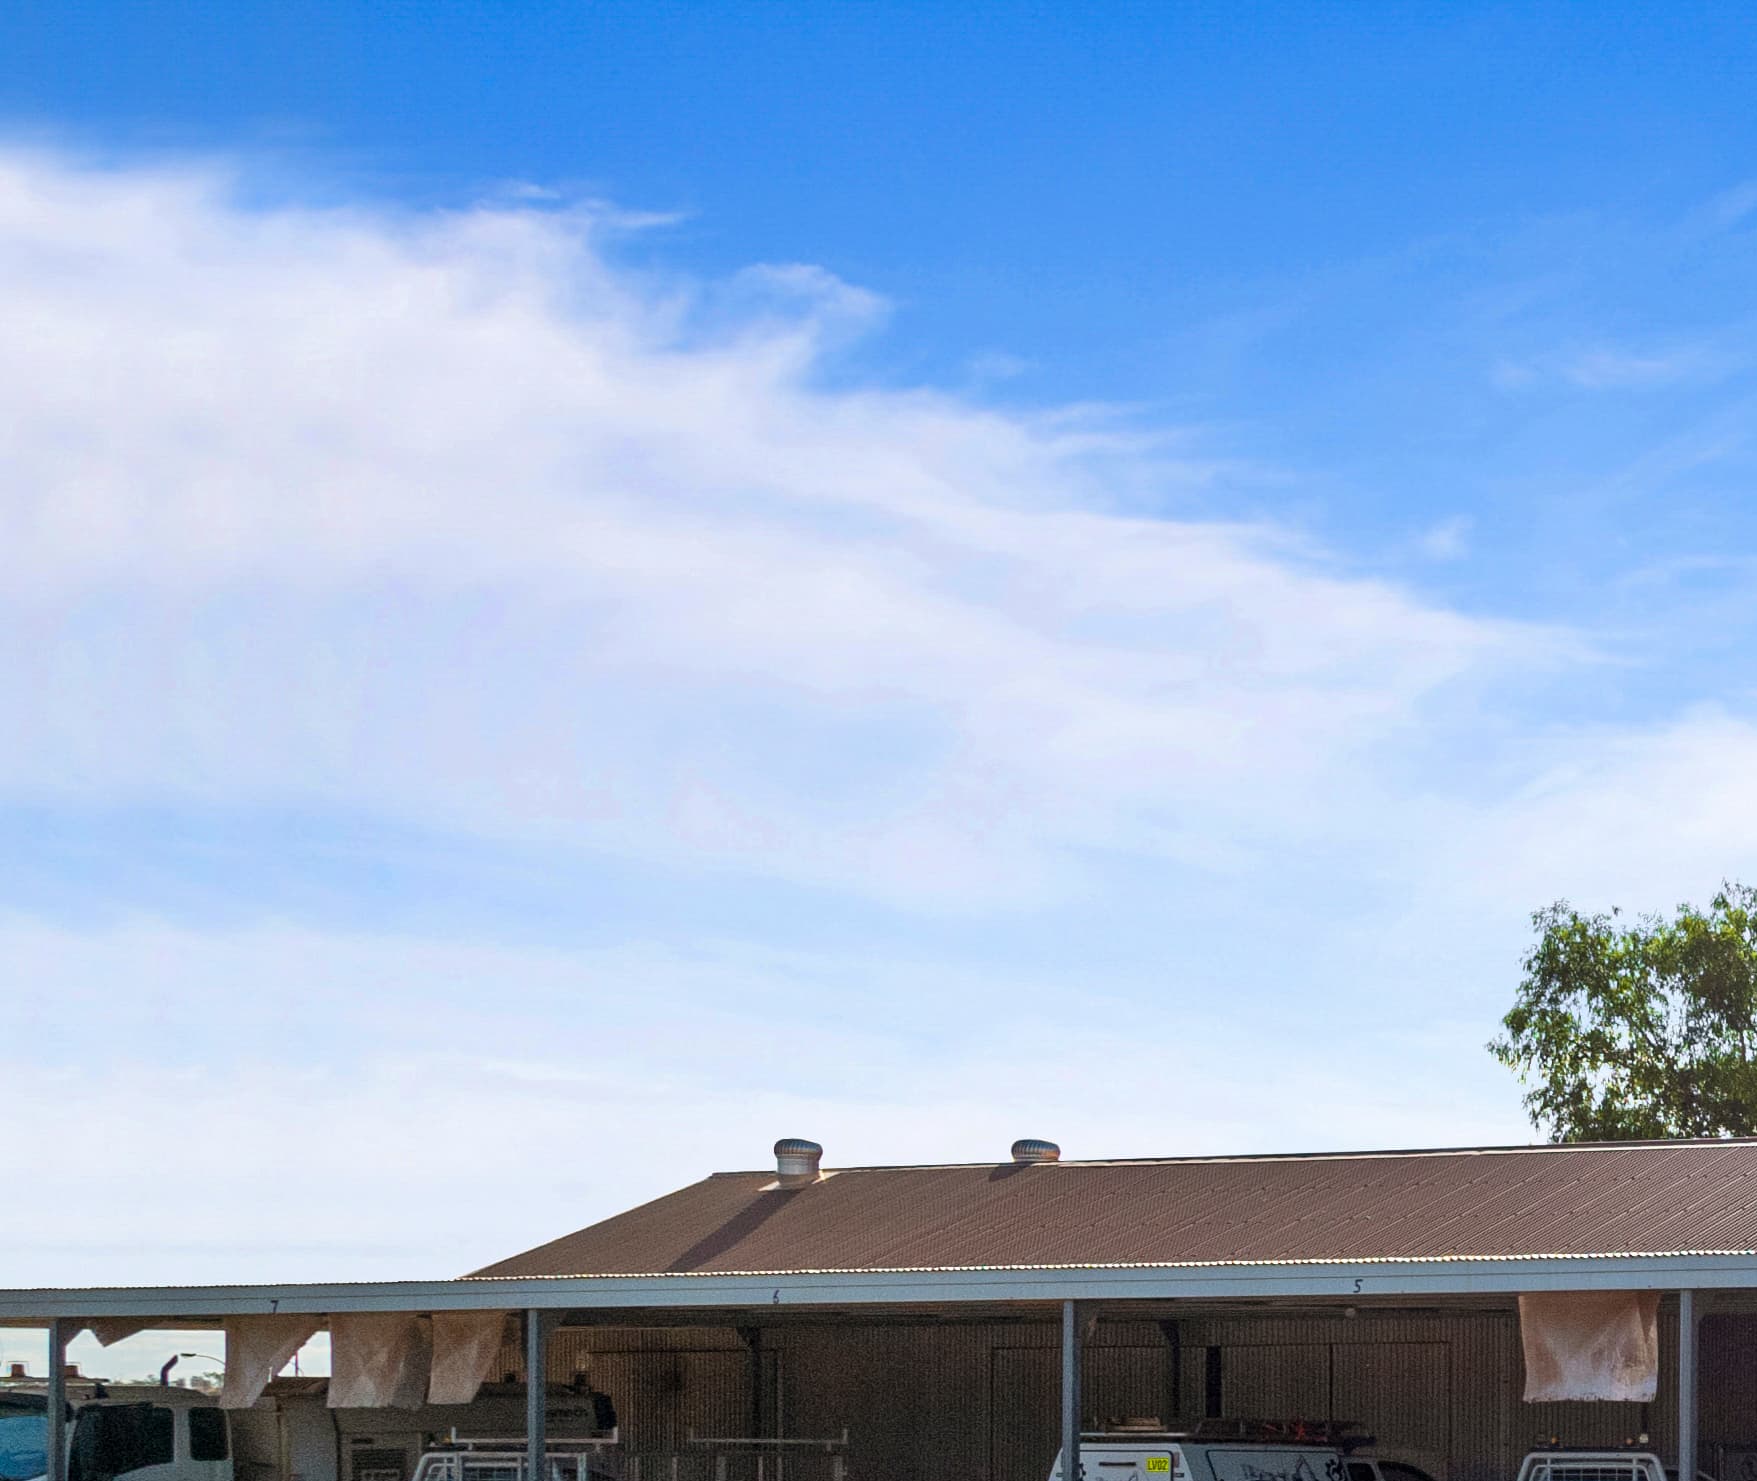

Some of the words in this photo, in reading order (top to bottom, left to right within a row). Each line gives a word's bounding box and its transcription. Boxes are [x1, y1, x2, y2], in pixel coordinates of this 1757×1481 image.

[1353, 1279, 1363, 1293] 5
[772, 1289, 780, 1305] 6
[271, 1299, 279, 1314] 7
[1147, 1460, 1169, 1471] LV02
